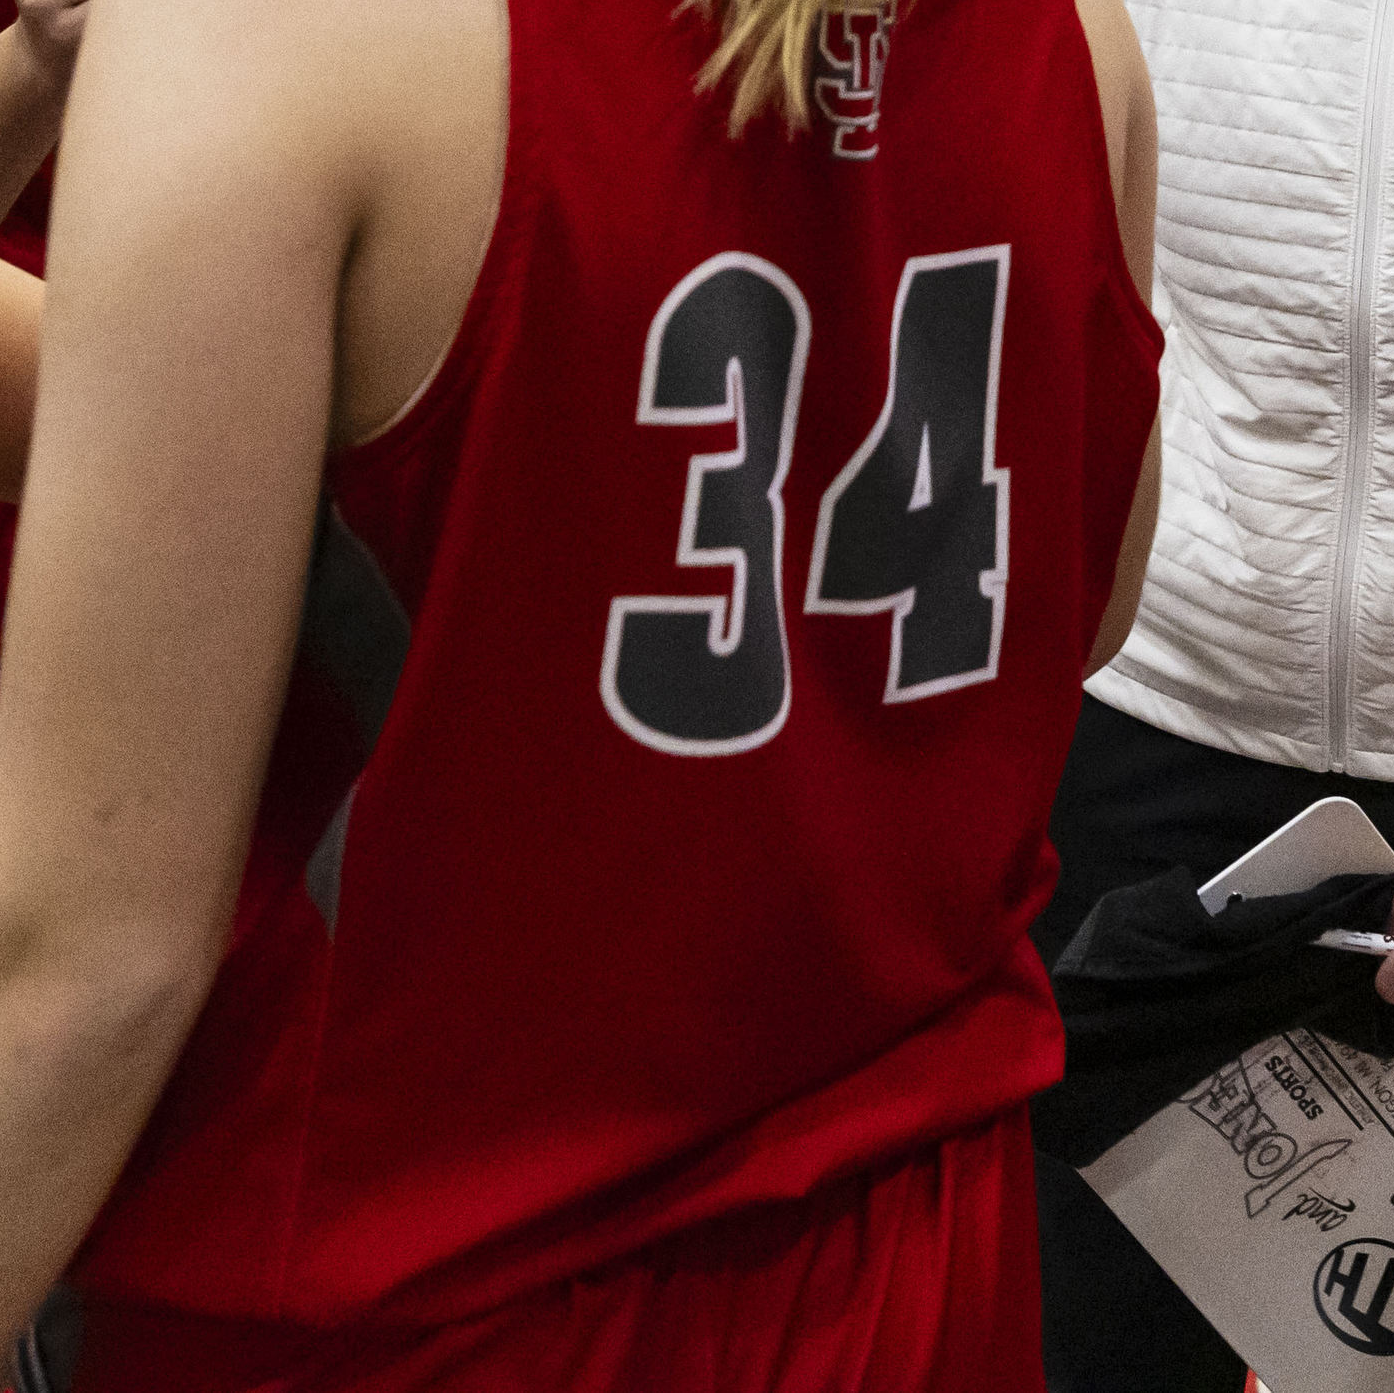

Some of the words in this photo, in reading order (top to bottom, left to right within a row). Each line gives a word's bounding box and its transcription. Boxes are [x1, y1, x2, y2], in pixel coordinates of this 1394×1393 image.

[601, 244, 1011, 757] 34
[1174, 1056, 1351, 1219] JONE
[1263, 1052, 1324, 1122] SPORTS
[1280, 1193, 1347, 1234] and
